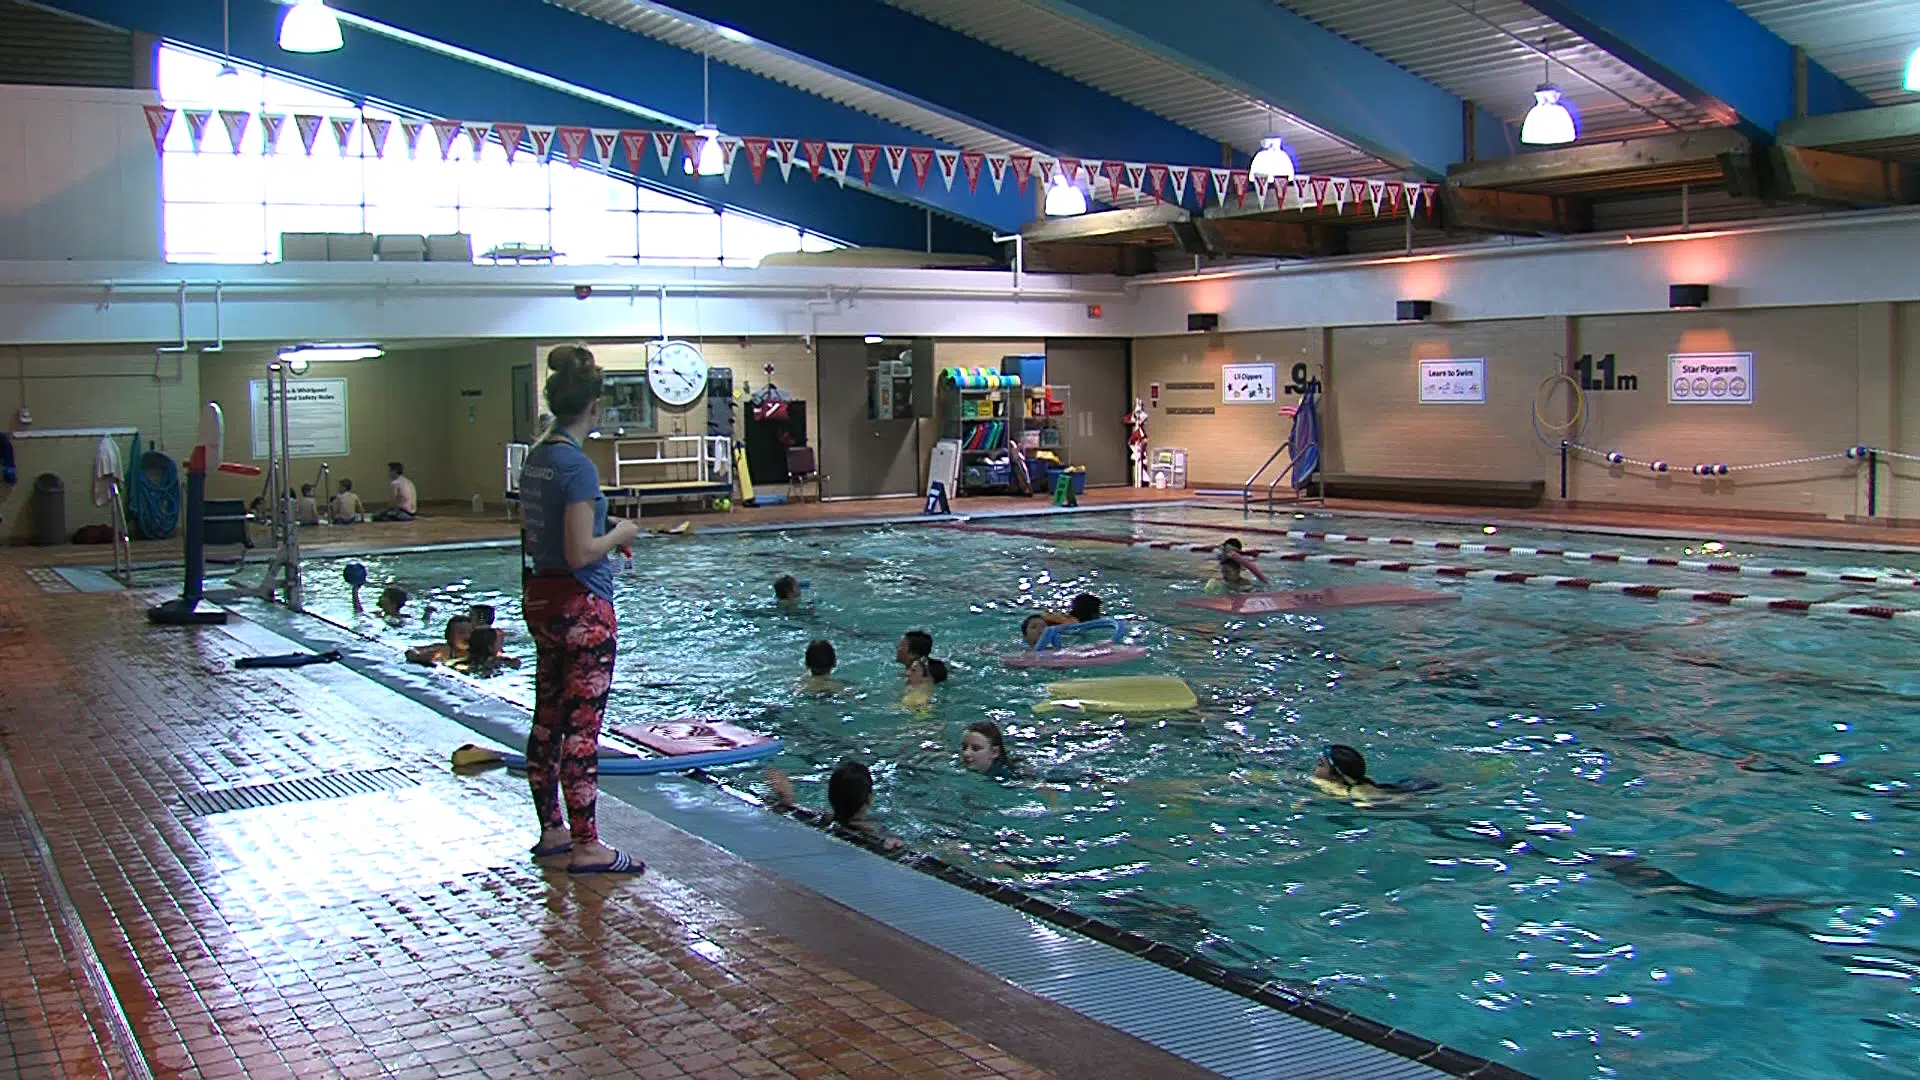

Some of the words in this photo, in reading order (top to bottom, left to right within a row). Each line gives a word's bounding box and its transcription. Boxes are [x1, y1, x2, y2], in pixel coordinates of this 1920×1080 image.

[468, 128, 488, 152] Y
[531, 131, 551, 155] Y
[563, 132, 585, 158] Y
[596, 135, 616, 159] Y
[624, 136, 644, 161] Y
[656, 133, 673, 157] Y
[749, 143, 766, 166] Y
[776, 141, 794, 164] Y
[807, 143, 824, 165] Y
[832, 149, 848, 171] Y
[858, 150, 876, 172] Y
[890, 147, 905, 169] Y
[911, 153, 930, 176] Y
[940, 156, 957, 176] Y
[991, 159, 1006, 180] Y
[1039, 162, 1054, 183] Y
[1085, 165, 1099, 185] Y
[1130, 168, 1144, 188] Y
[1173, 171, 1186, 190] Y
[1215, 174, 1228, 193] Y
[1682, 365, 1699, 373] Star
[1701, 364, 1737, 375] Program
